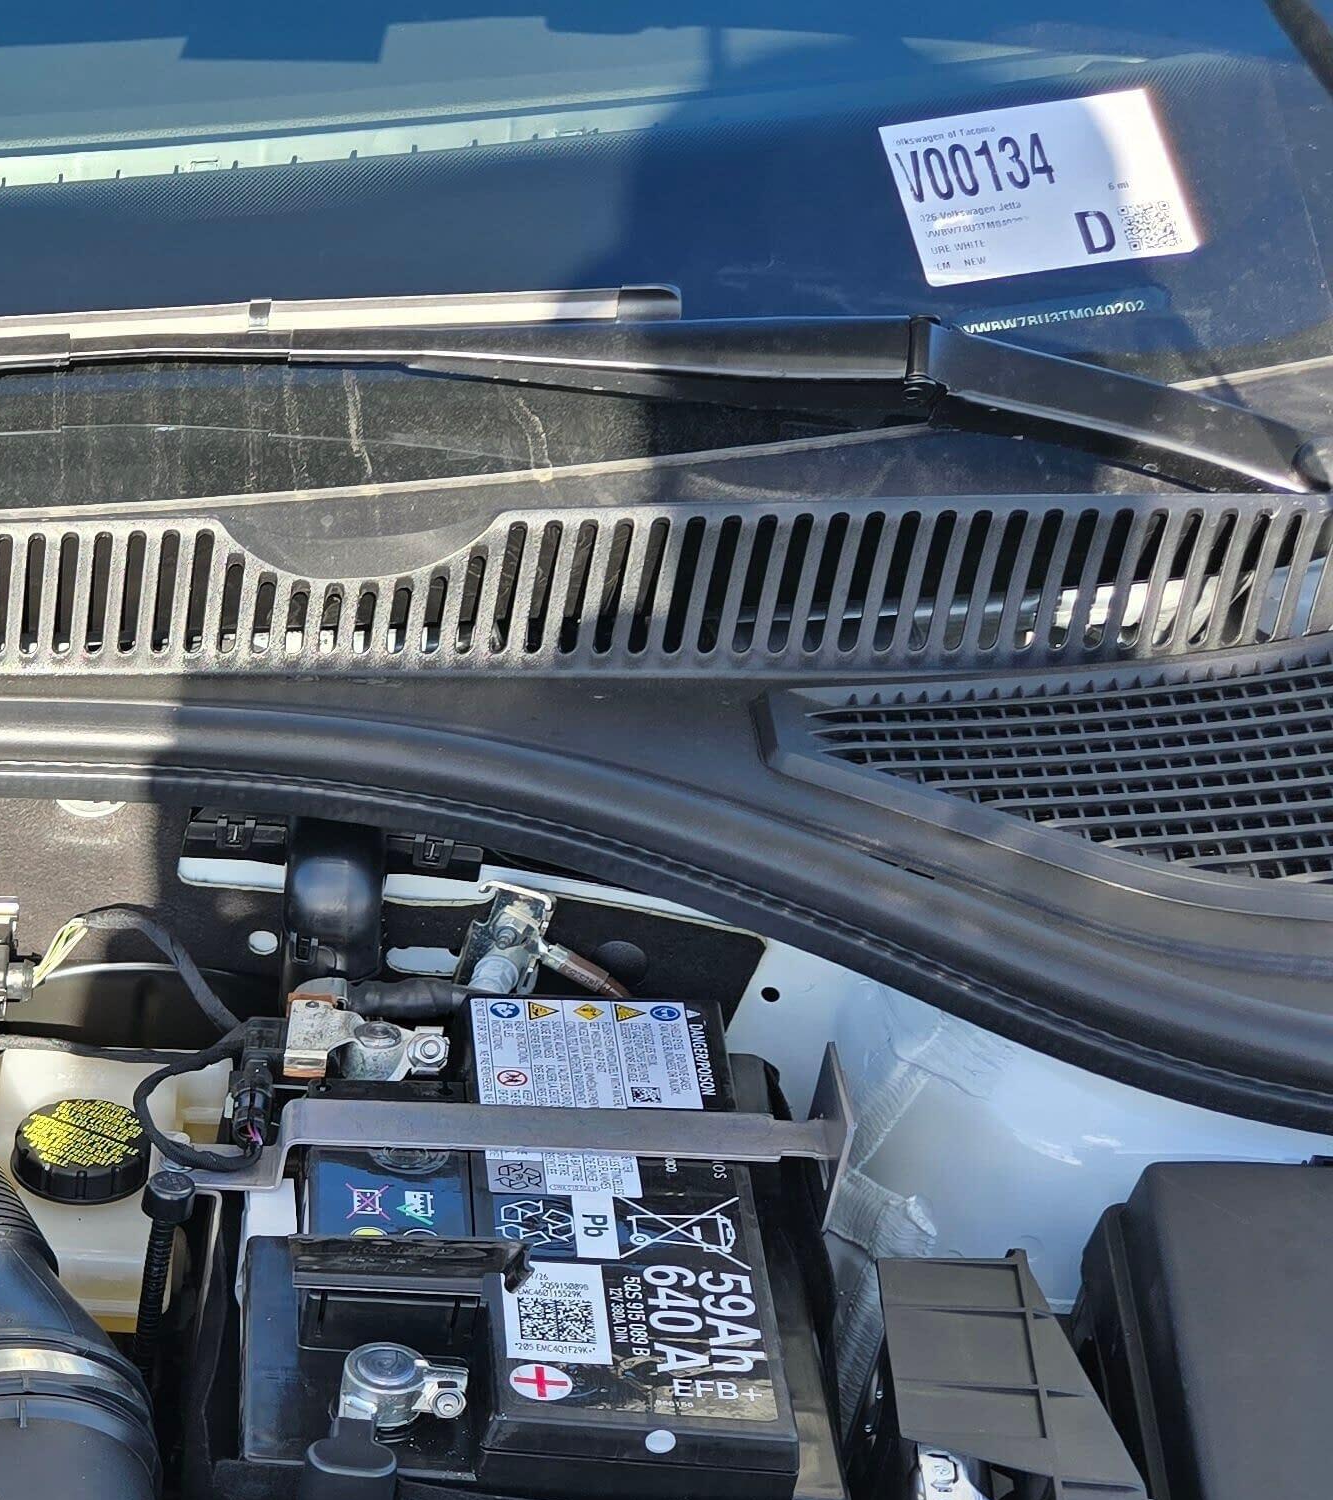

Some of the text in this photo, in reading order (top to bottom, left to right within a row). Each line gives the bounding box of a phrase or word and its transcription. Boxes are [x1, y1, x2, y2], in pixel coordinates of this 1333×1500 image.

[892, 131, 945, 148] olkswagen
[893, 130, 1058, 206] V00134
[1107, 180, 1130, 191] 6 mi
[918, 200, 1022, 223] 026 Volkswagen Jetta
[929, 238, 986, 255] URE WHITE
[1073, 206, 1120, 255] D
[962, 255, 988, 267] NEW
[687, 1023, 717, 1096] DANGER/POISON
[581, 1213, 609, 1237] Pb
[608, 1286, 628, 1343] 12V 380A DIN
[621, 1275, 650, 1356] 5QS 915 089 B
[641, 1264, 703, 1333] 640
[697, 1269, 766, 1374] 59Ah
[652, 1341, 710, 1376] A
[672, 1378, 762, 1401] EFB+
